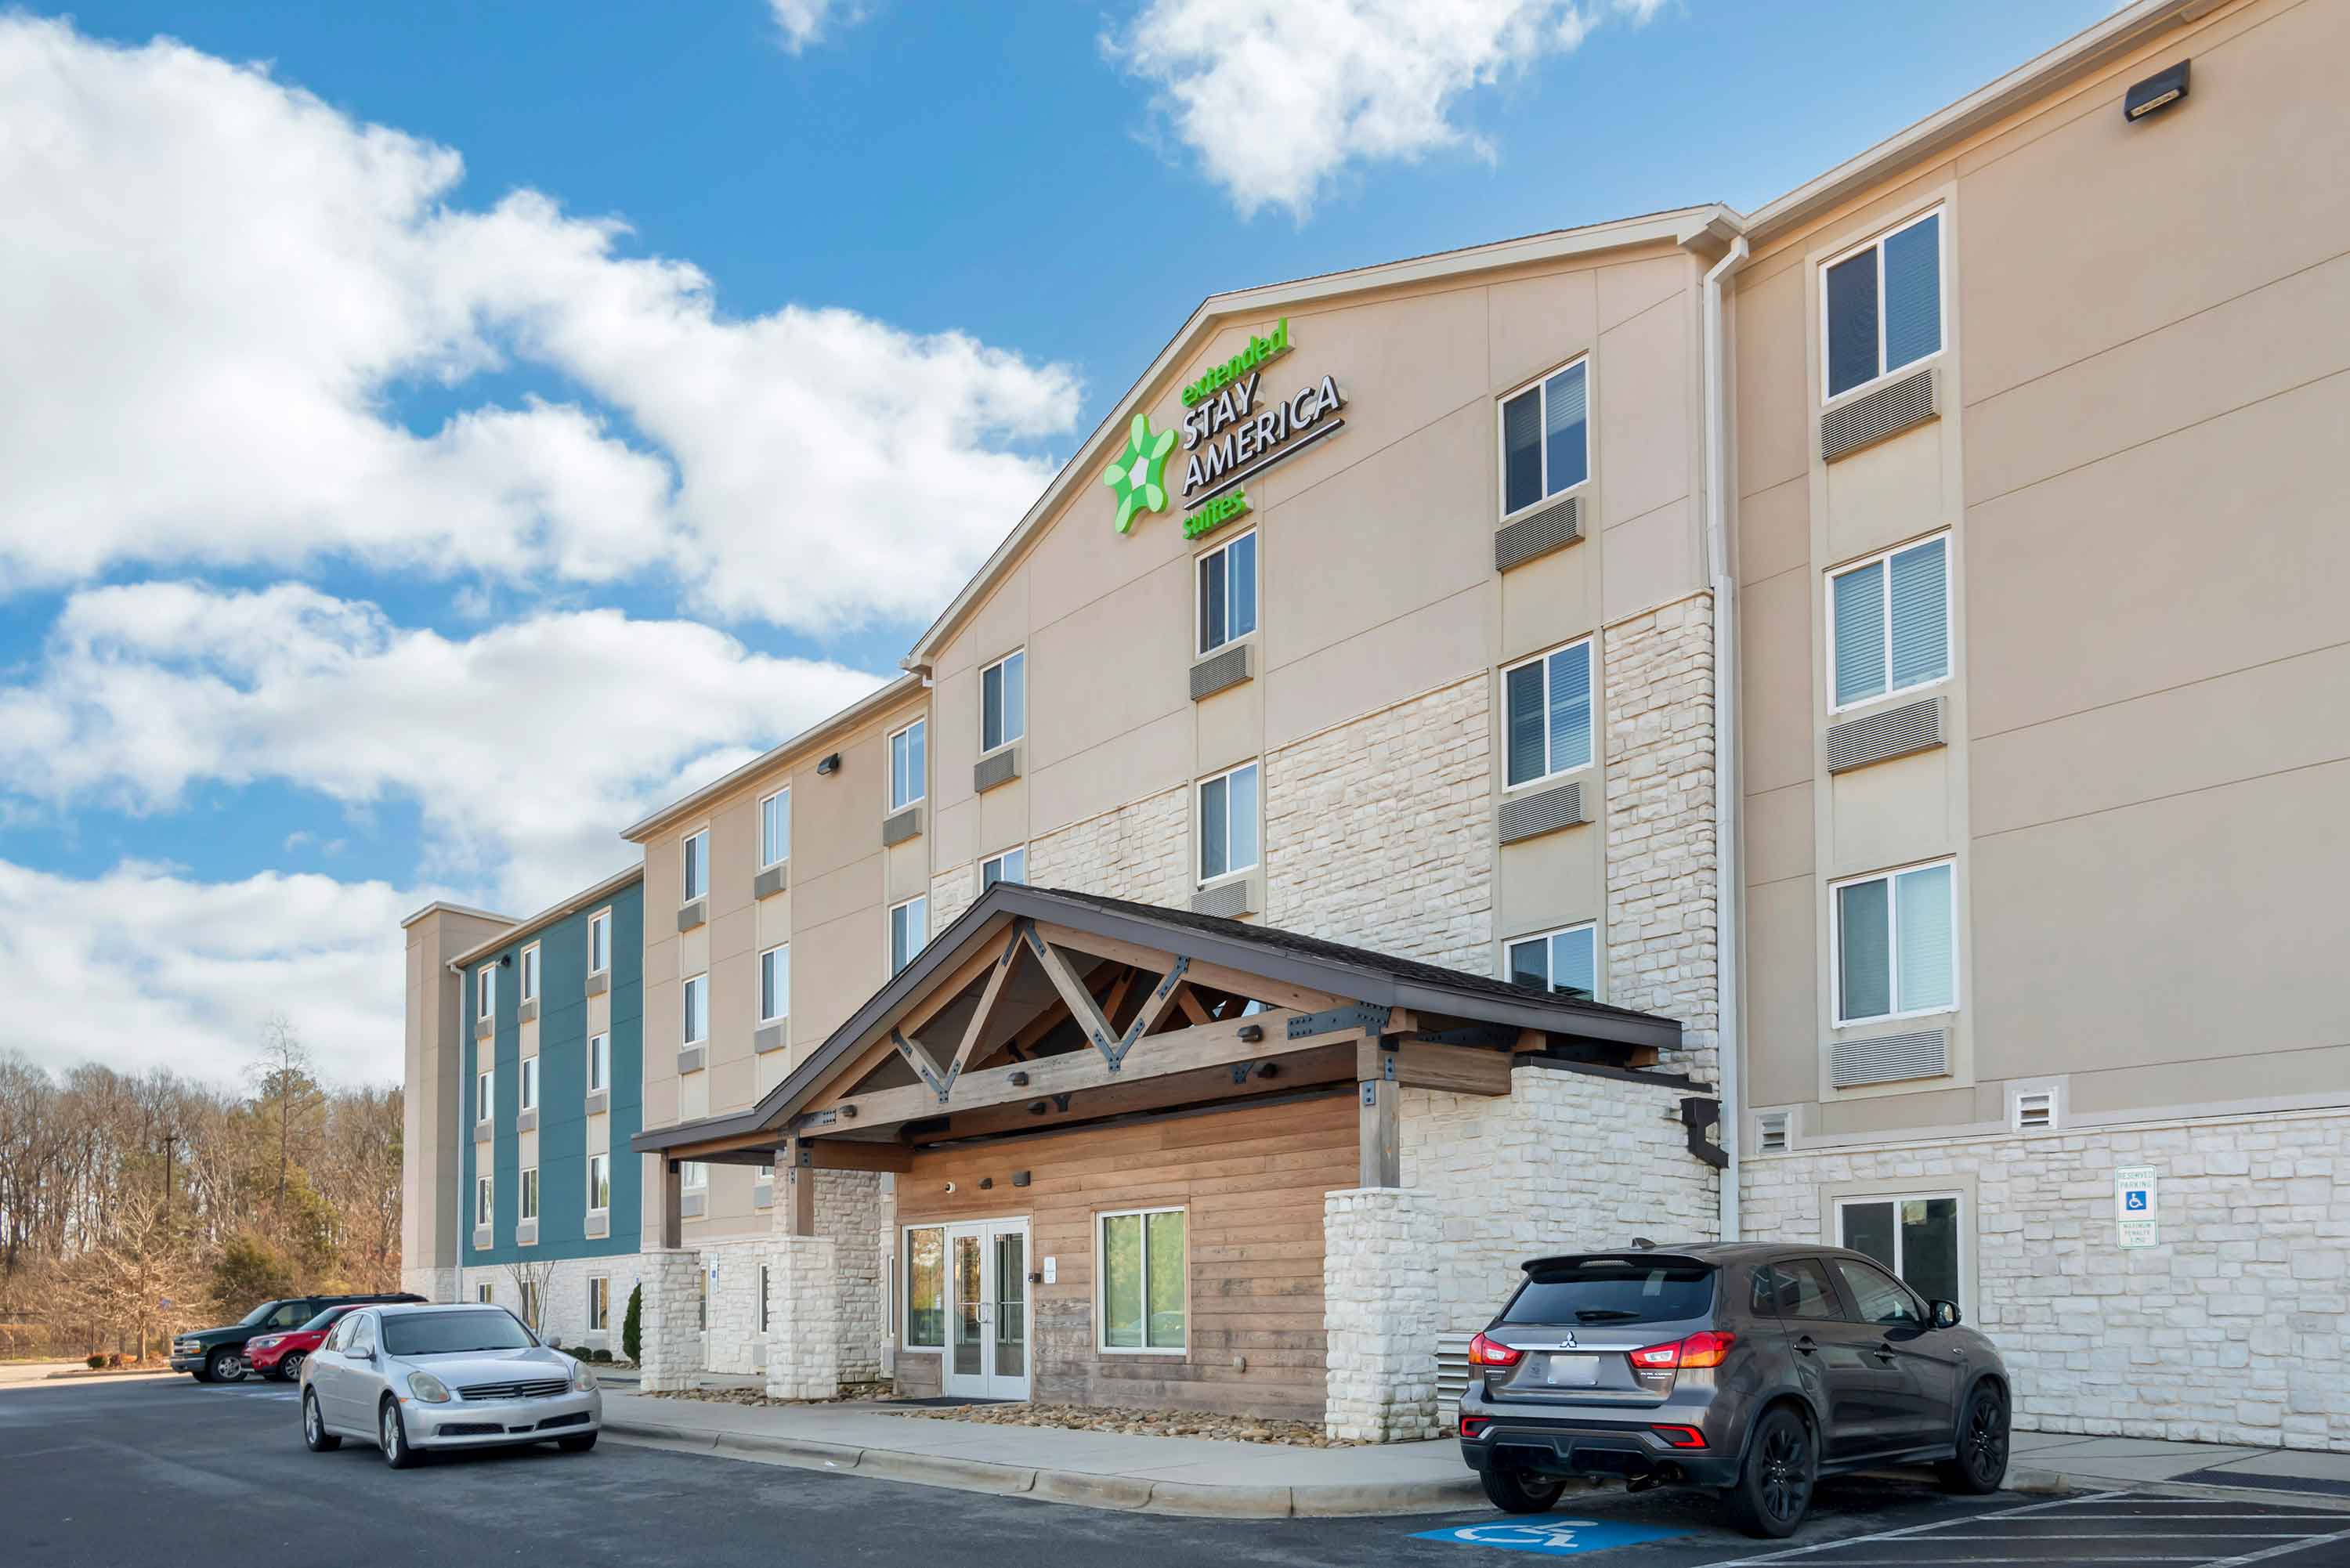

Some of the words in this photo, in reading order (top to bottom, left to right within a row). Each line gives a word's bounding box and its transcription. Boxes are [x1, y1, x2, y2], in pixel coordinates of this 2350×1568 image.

[1181, 316, 1288, 407] extended
[1182, 375, 1343, 496] AMERICA
[1183, 371, 1260, 450] STAY
[1183, 490, 1247, 540] suites
[2118, 1170, 2153, 1179] RESERVED
